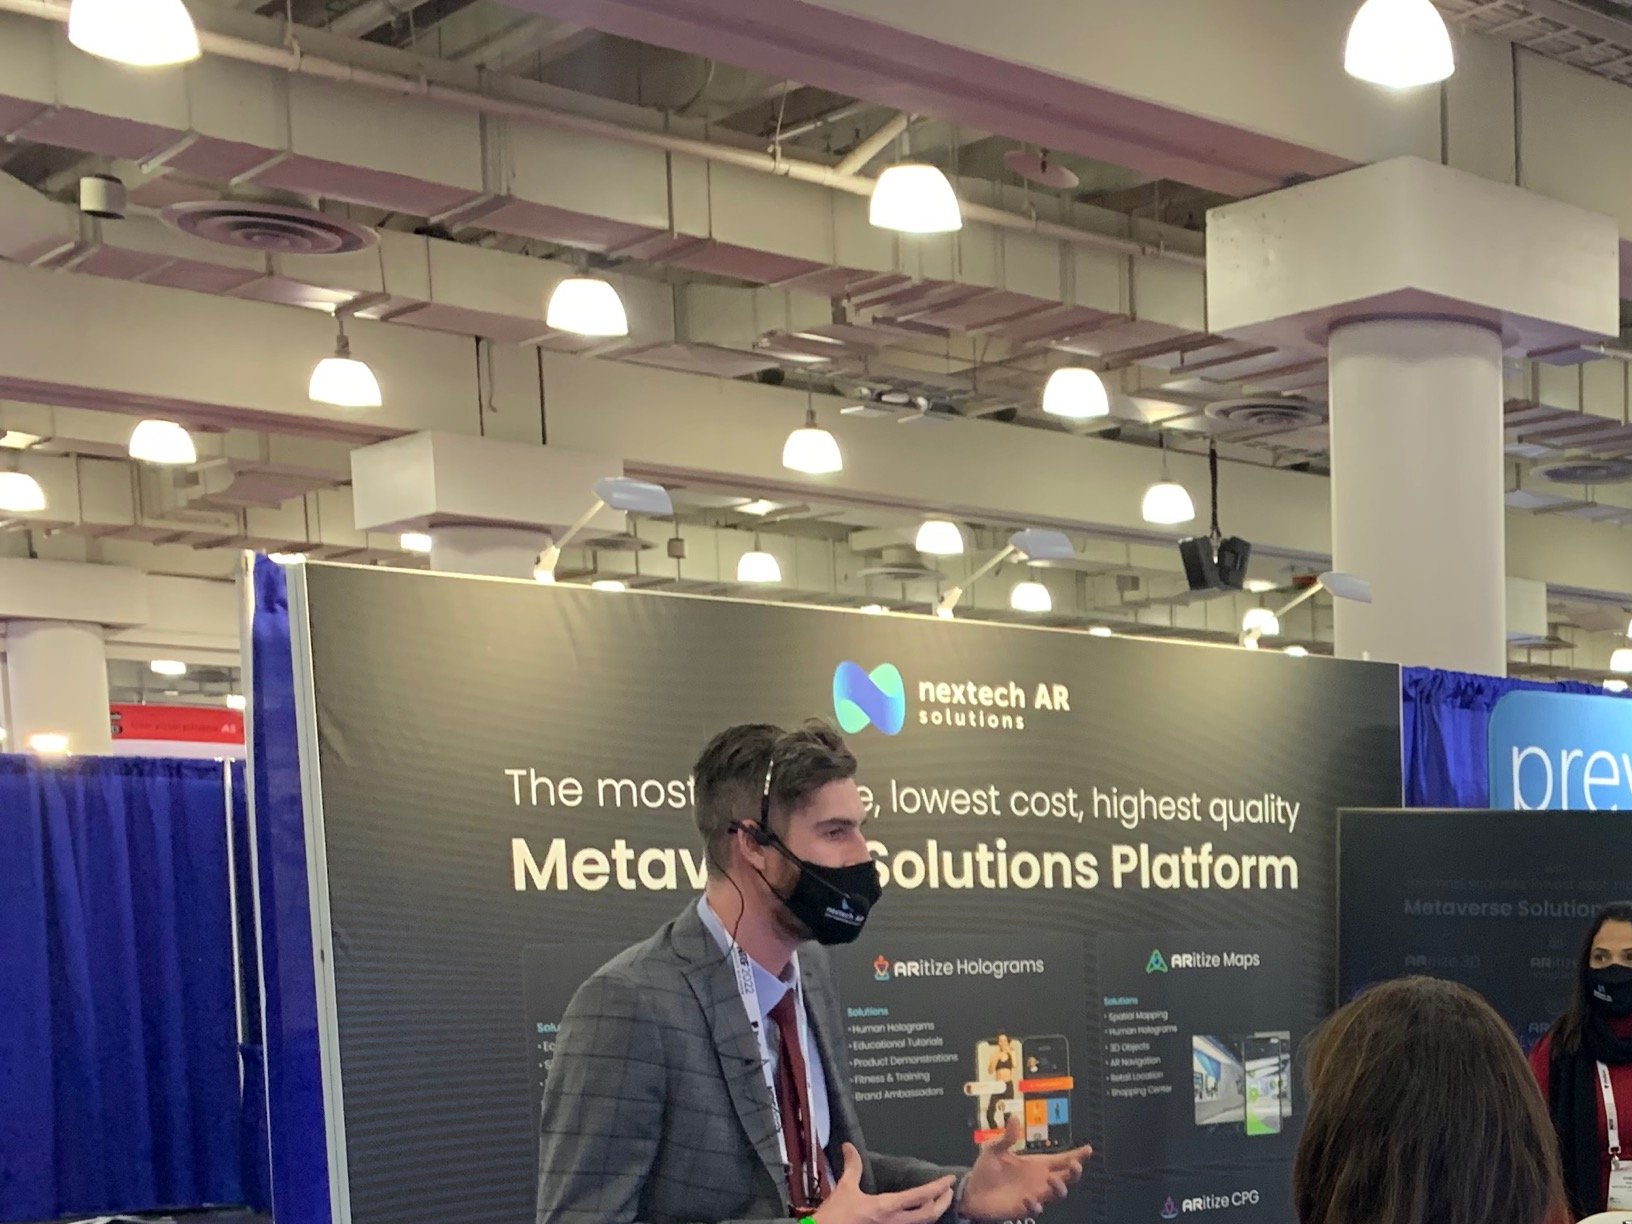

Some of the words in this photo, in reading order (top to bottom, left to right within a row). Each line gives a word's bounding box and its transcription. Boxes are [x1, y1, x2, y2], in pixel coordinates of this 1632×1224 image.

[918, 679, 1025, 710] nextech
[1034, 683, 1070, 712] AR
[918, 709, 1025, 730] solutions
[504, 767, 583, 807] The
[597, 773, 696, 808] most
[891, 778, 1001, 817] lowest
[1010, 787, 1084, 823] cost,
[1093, 786, 1202, 829] highest
[1208, 793, 1301, 833] quality
[511, 838, 707, 892] Metav
[864, 839, 1100, 890] Solutions
[1111, 842, 1299, 890] Platform
[1403, 898, 1513, 917] Metaverse
[893, 959, 954, 978] ARitize
[956, 957, 1045, 979] Holograms
[1170, 951, 1221, 969] ARitize
[1223, 951, 1261, 970] Maps
[847, 1007, 889, 1018] Solutions
[1136, 1010, 1169, 1022] Mapping
[852, 1023, 885, 1033] Human
[887, 1021, 935, 1033] Holograms
[1109, 1026, 1137, 1036] Human
[853, 1038, 906, 1051] Educational
[907, 1037, 943, 1048] Tutorials
[853, 1056, 888, 1068] Product
[889, 1053, 959, 1067] Demonstrations
[854, 1074, 885, 1085] Fitness
[886, 1073, 894, 1084] &
[896, 1072, 930, 1084] Training
[855, 1090, 882, 1101] Brand
[884, 1087, 944, 1100] Ambassadors
[1182, 1193, 1230, 1213] ARitize
[1231, 1189, 1260, 1207] CPG
